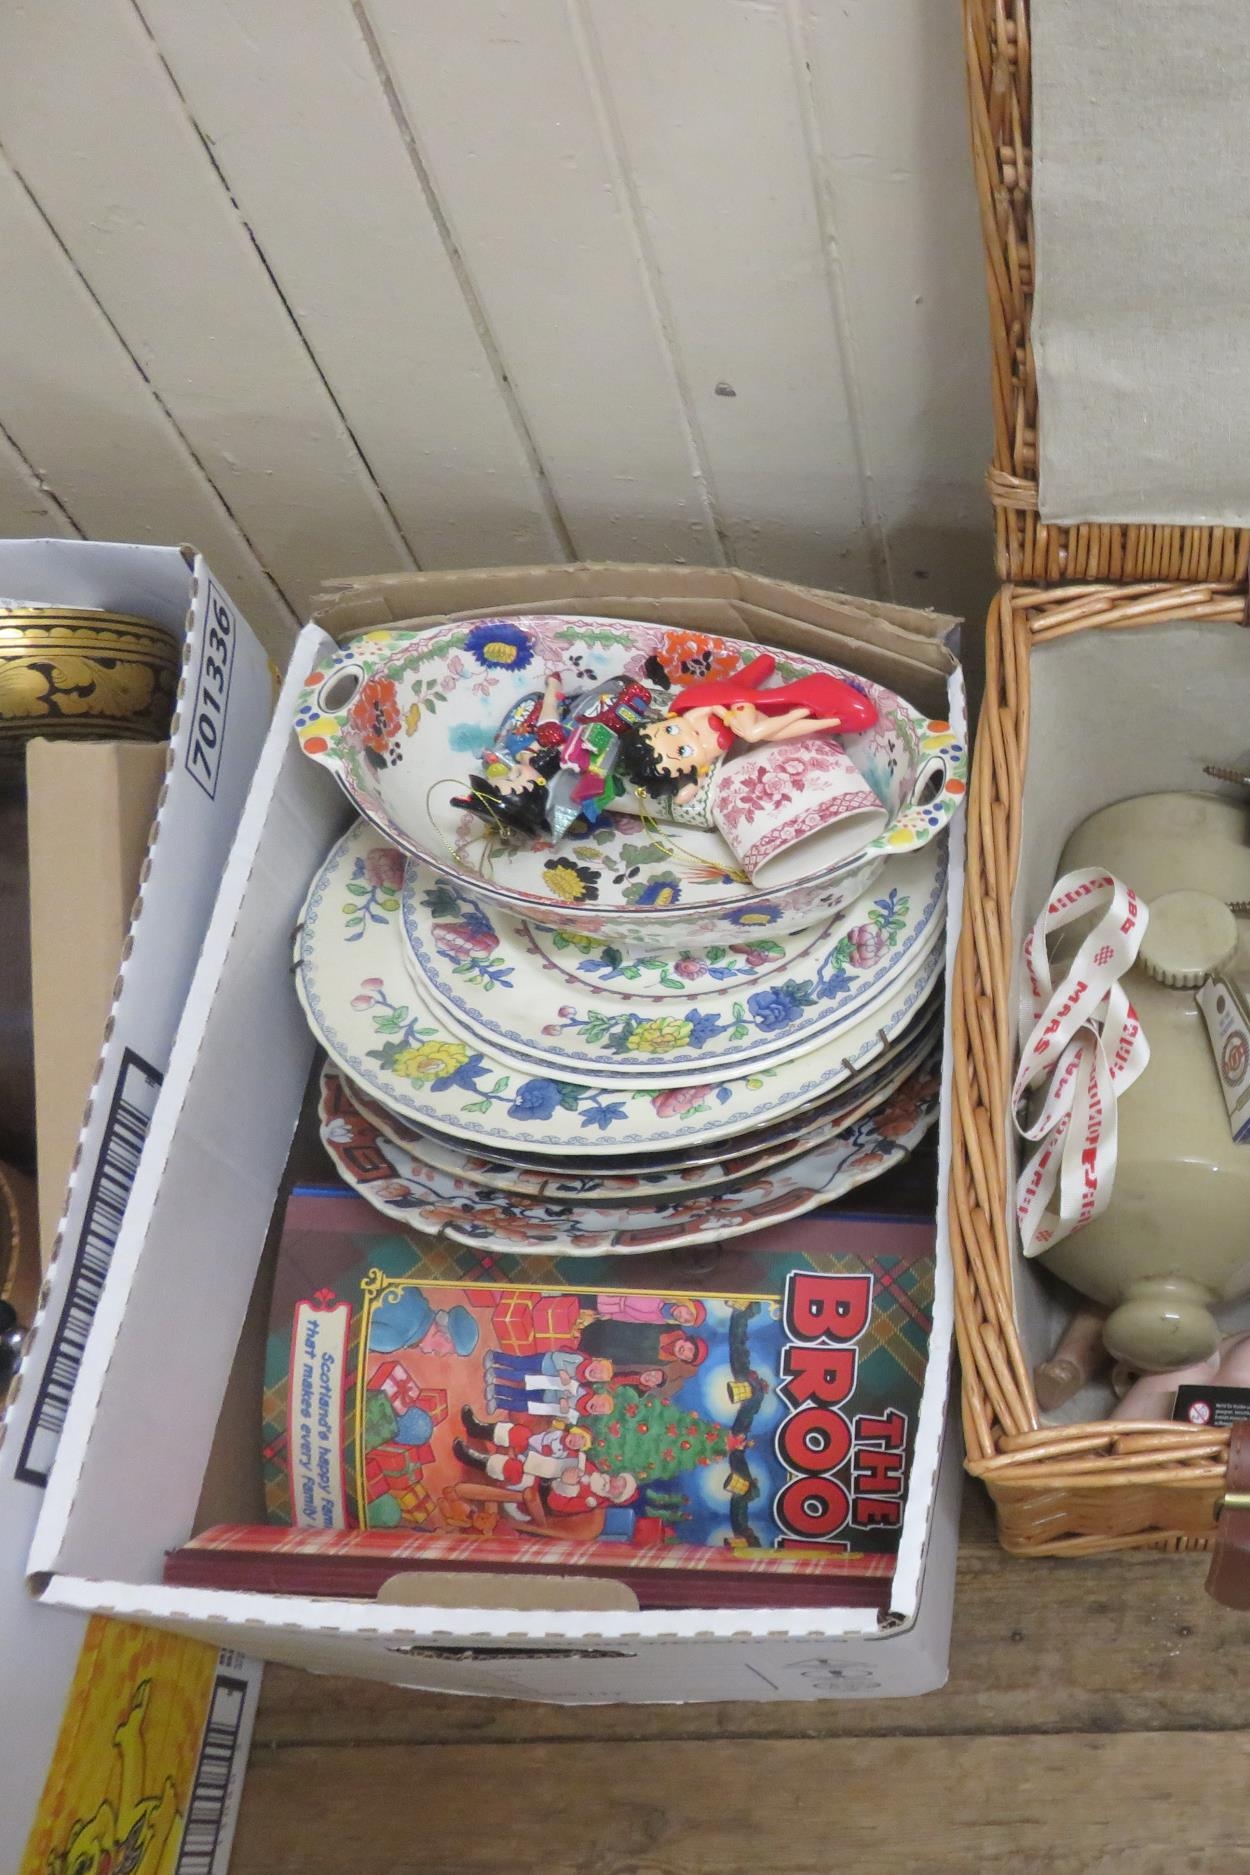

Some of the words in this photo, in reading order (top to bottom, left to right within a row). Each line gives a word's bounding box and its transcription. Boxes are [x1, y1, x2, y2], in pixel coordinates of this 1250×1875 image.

[192, 598, 230, 780] 701336
[1034, 981, 1088, 1055] MARS
[303, 1318, 320, 1361] that
[300, 1363, 314, 1419] makes
[317, 1351, 335, 1442] Scotland's
[773, 1269, 874, 1552] BROO
[299, 1423, 313, 1472] every
[317, 1447, 333, 1495] happy
[850, 1407, 908, 1531] THE
